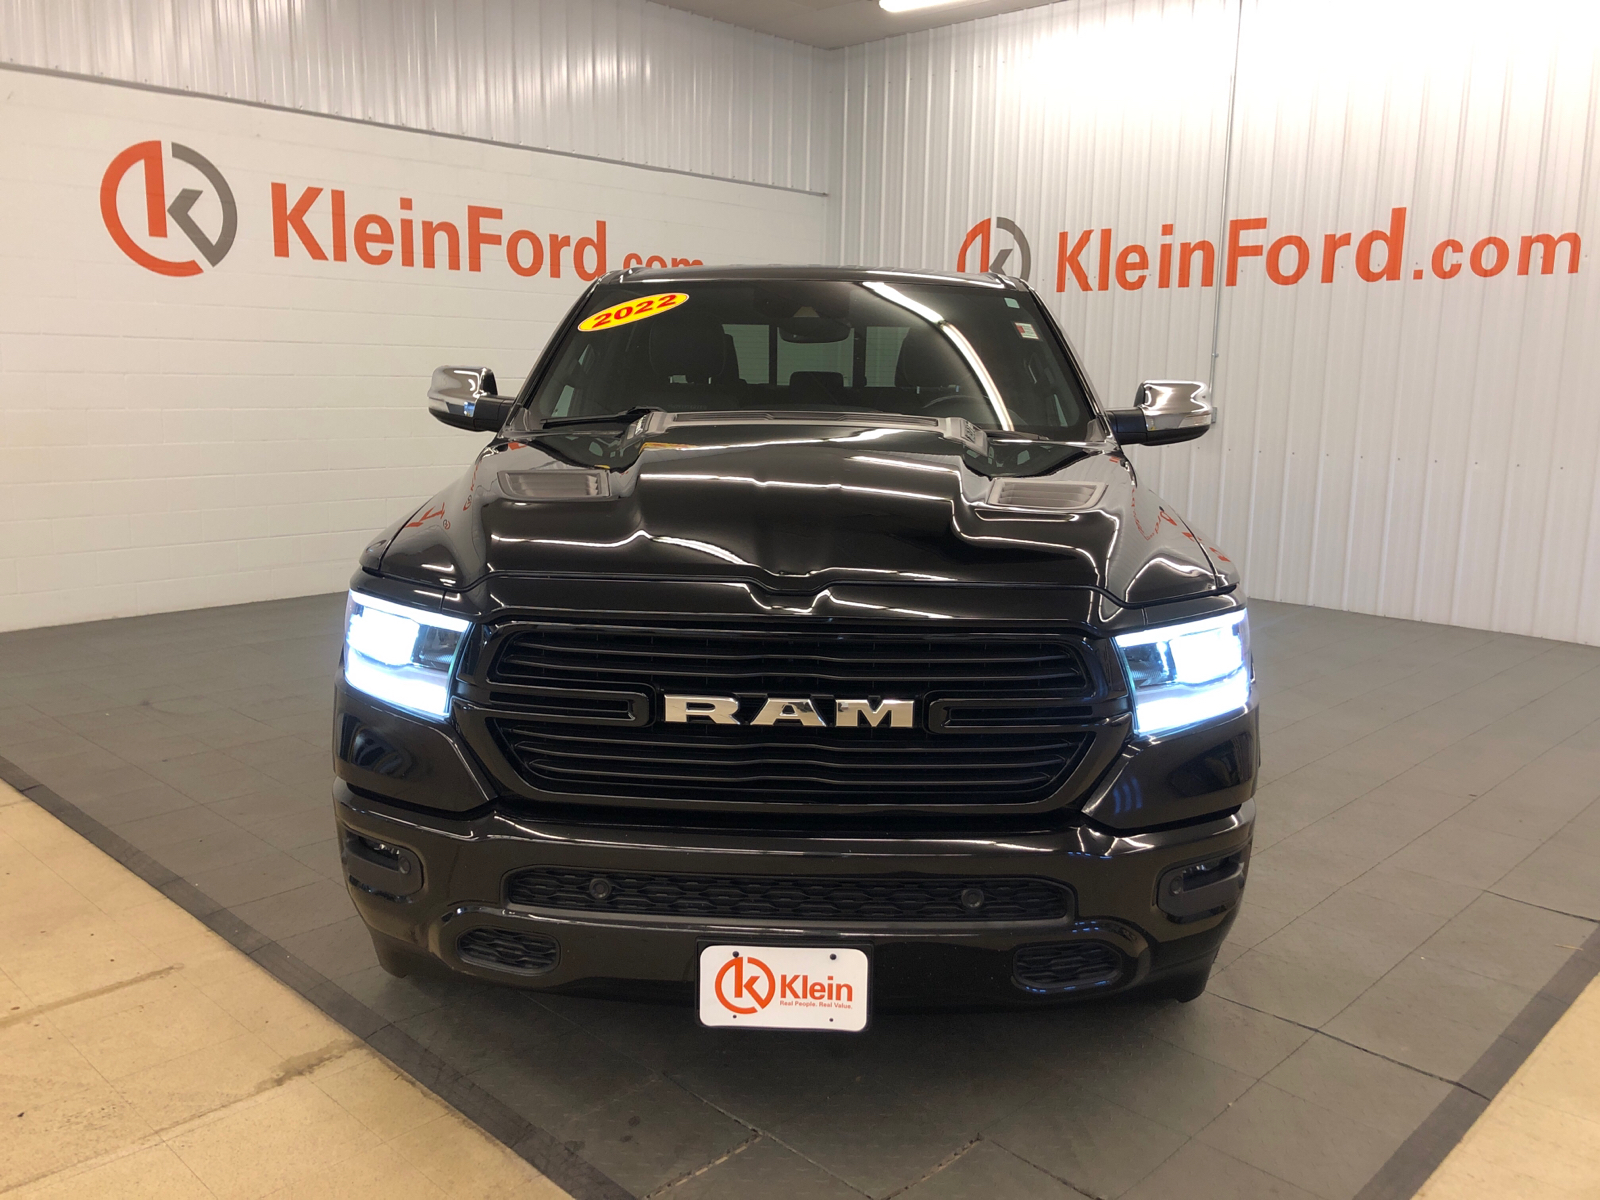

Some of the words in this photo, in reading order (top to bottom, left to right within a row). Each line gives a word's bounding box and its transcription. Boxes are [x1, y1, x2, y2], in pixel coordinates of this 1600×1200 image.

[271, 182, 704, 282] KleinFord
[1056, 207, 1581, 292] KleinFord.com
[593, 295, 677, 328] 2022
[664, 694, 914, 727] RAM
[780, 974, 853, 1002] Klein
